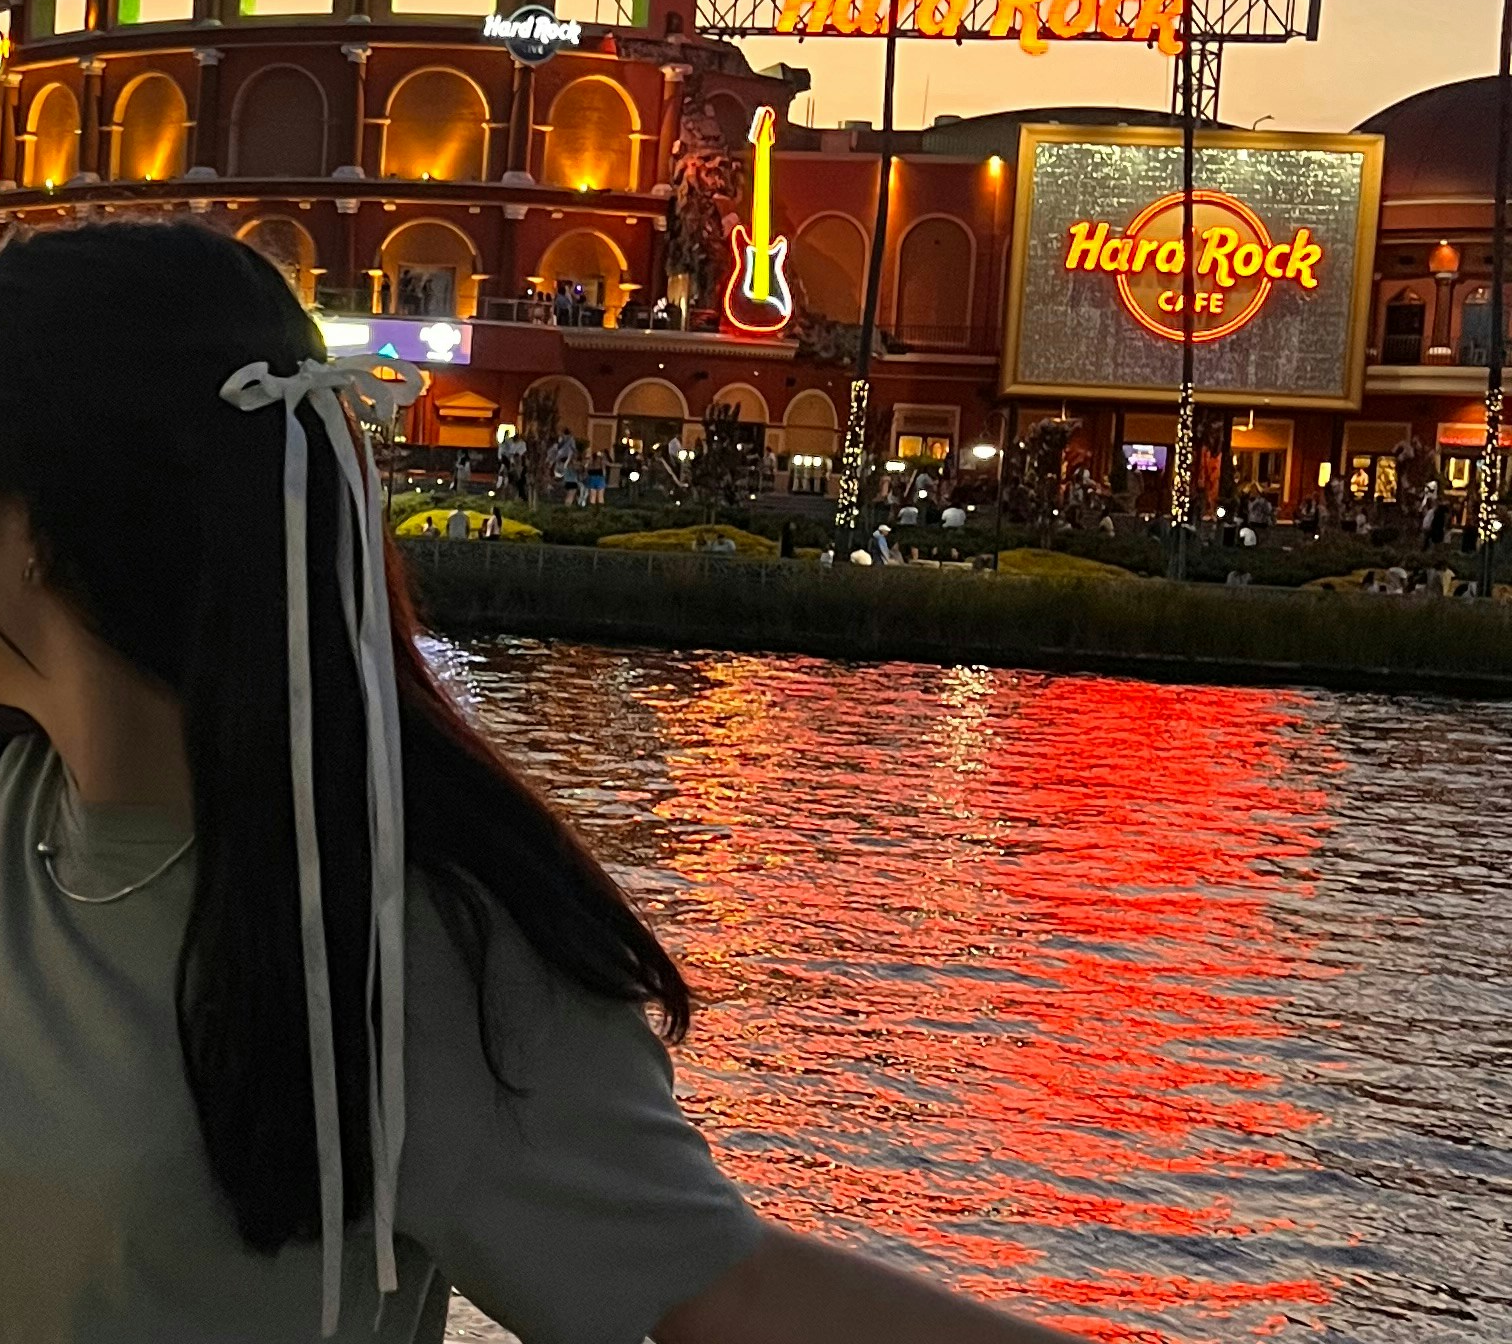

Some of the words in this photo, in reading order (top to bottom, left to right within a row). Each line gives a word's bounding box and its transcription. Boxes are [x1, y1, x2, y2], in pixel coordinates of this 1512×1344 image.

[484, 14, 535, 39] Hard
[533, 16, 581, 45] Rock
[1198, 227, 1322, 289] Rock
